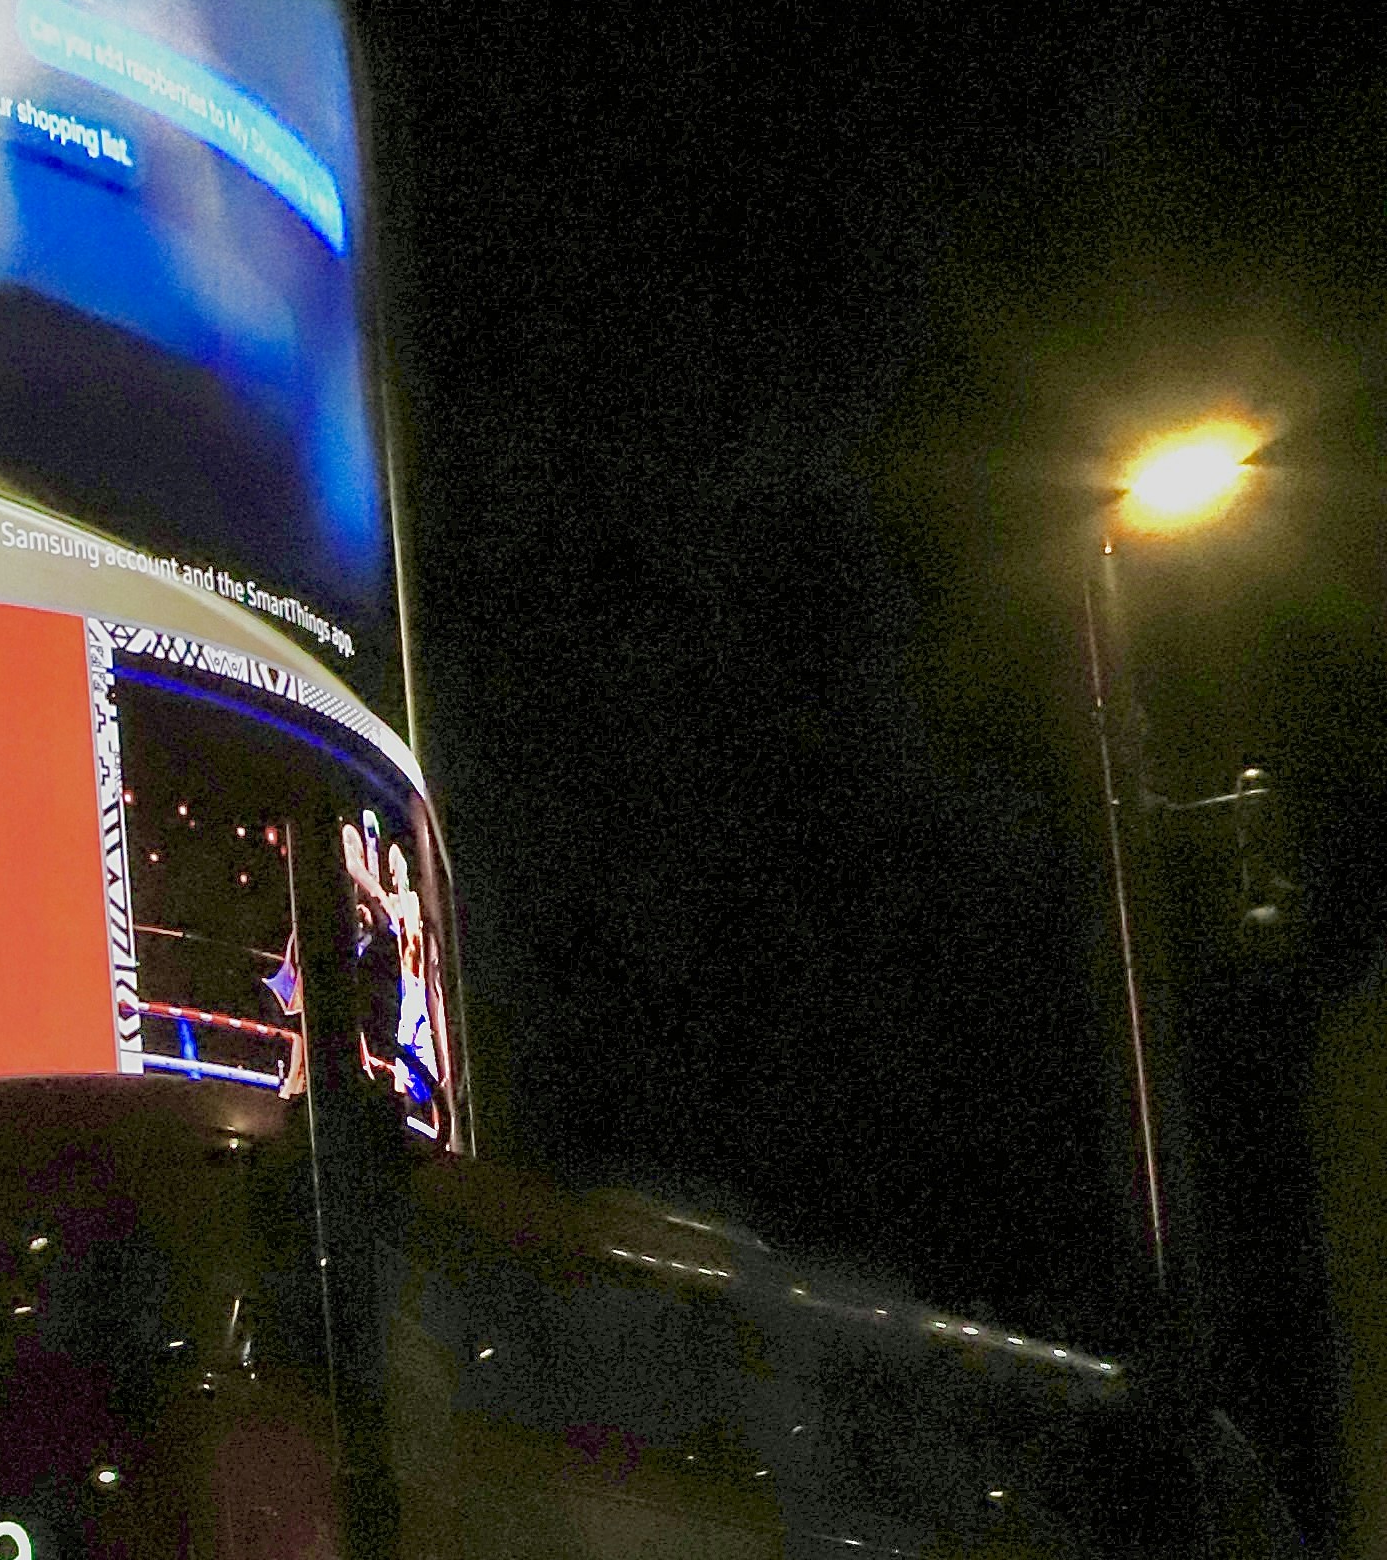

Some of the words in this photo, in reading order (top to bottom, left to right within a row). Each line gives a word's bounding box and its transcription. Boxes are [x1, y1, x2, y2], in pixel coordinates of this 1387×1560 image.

[17, 99, 100, 158] shopping
[101, 129, 132, 168] list.
[1, 521, 100, 568] Samsung
[104, 548, 180, 581] account
[182, 564, 215, 592] and
[217, 571, 246, 601] the
[246, 580, 330, 643] SmartThings
[331, 624, 355, 657] app.
